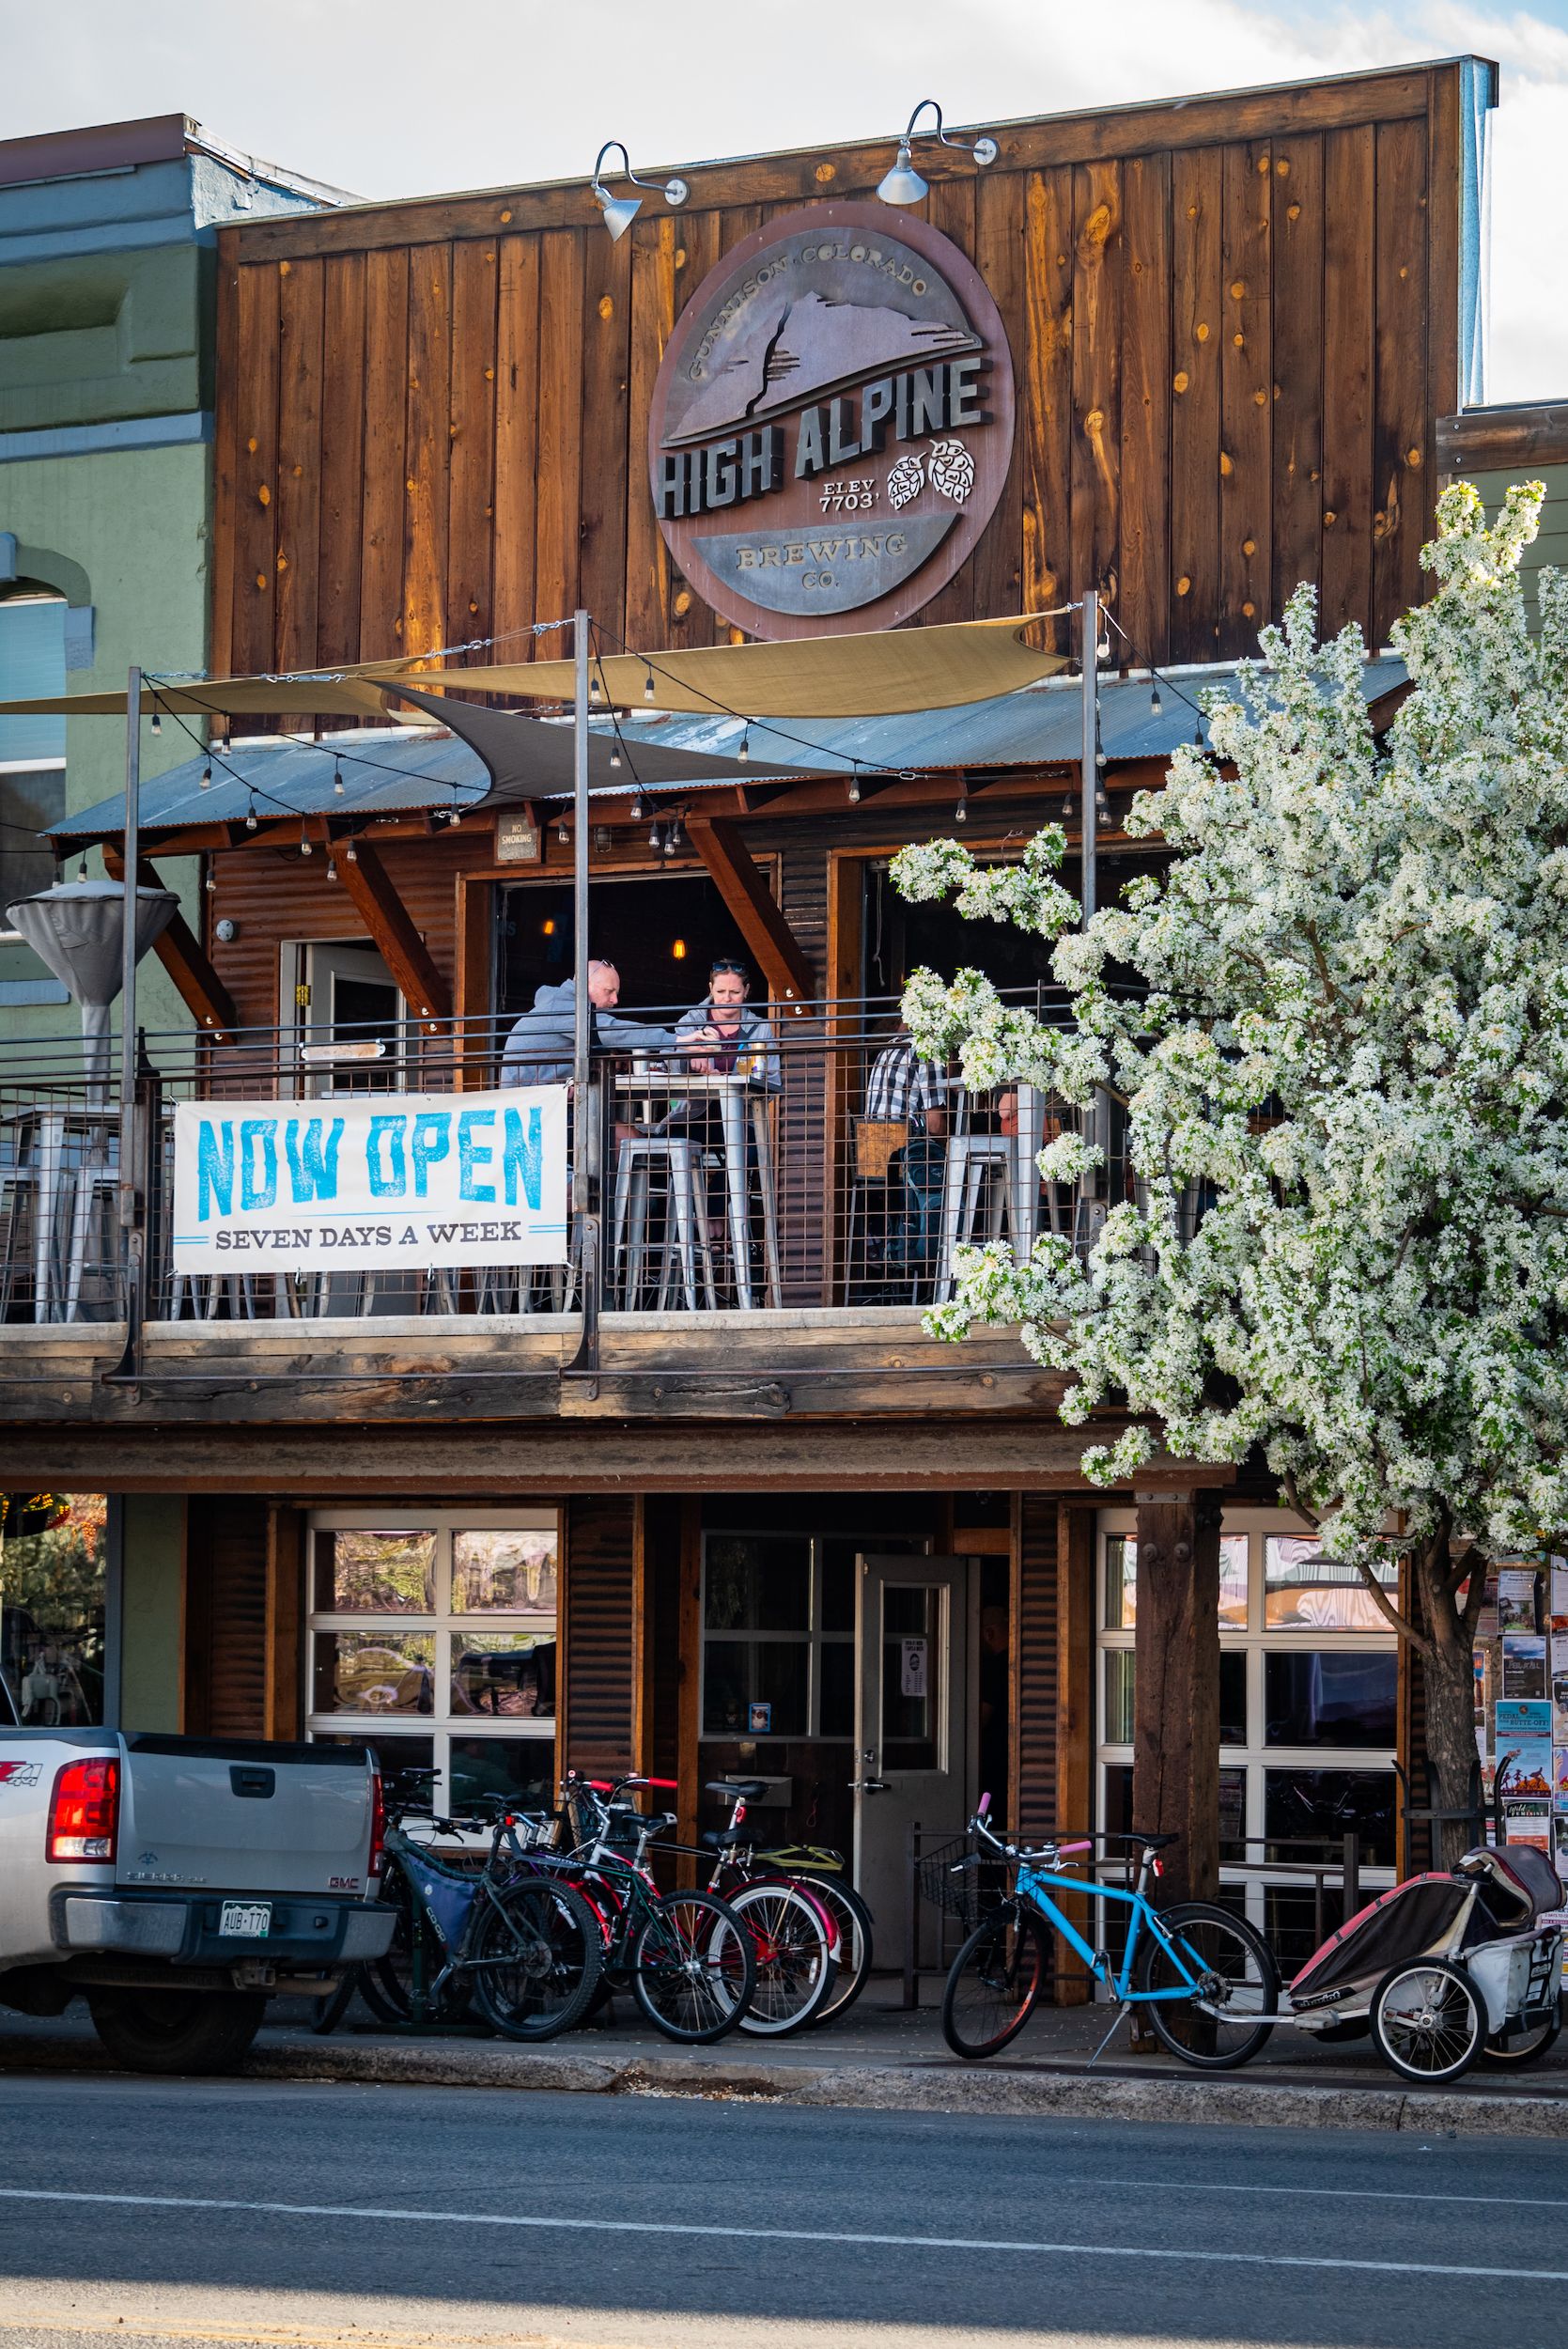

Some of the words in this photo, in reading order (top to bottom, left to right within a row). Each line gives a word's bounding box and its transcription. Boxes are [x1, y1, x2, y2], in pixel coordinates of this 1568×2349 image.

[689, 256, 790, 382] GUNNISON
[800, 243, 927, 298] COLORADO
[658, 425, 784, 520] HIGH
[794, 357, 993, 481] ALPINE
[822, 478, 876, 496] ELEV
[737, 533, 908, 572] BREWING
[801, 570, 841, 591] CO.
[501, 833, 532, 845] SMOKING
[511, 824, 521, 833] NO
[197, 1116, 346, 1222] NOW
[365, 1105, 543, 1211] OPEN
[215, 1228, 313, 1251] SEVEN
[319, 1225, 392, 1248] DAYS
[398, 1225, 419, 1245] A
[427, 1221, 522, 1244] WEEK
[328, 1877, 359, 1889] GMC
